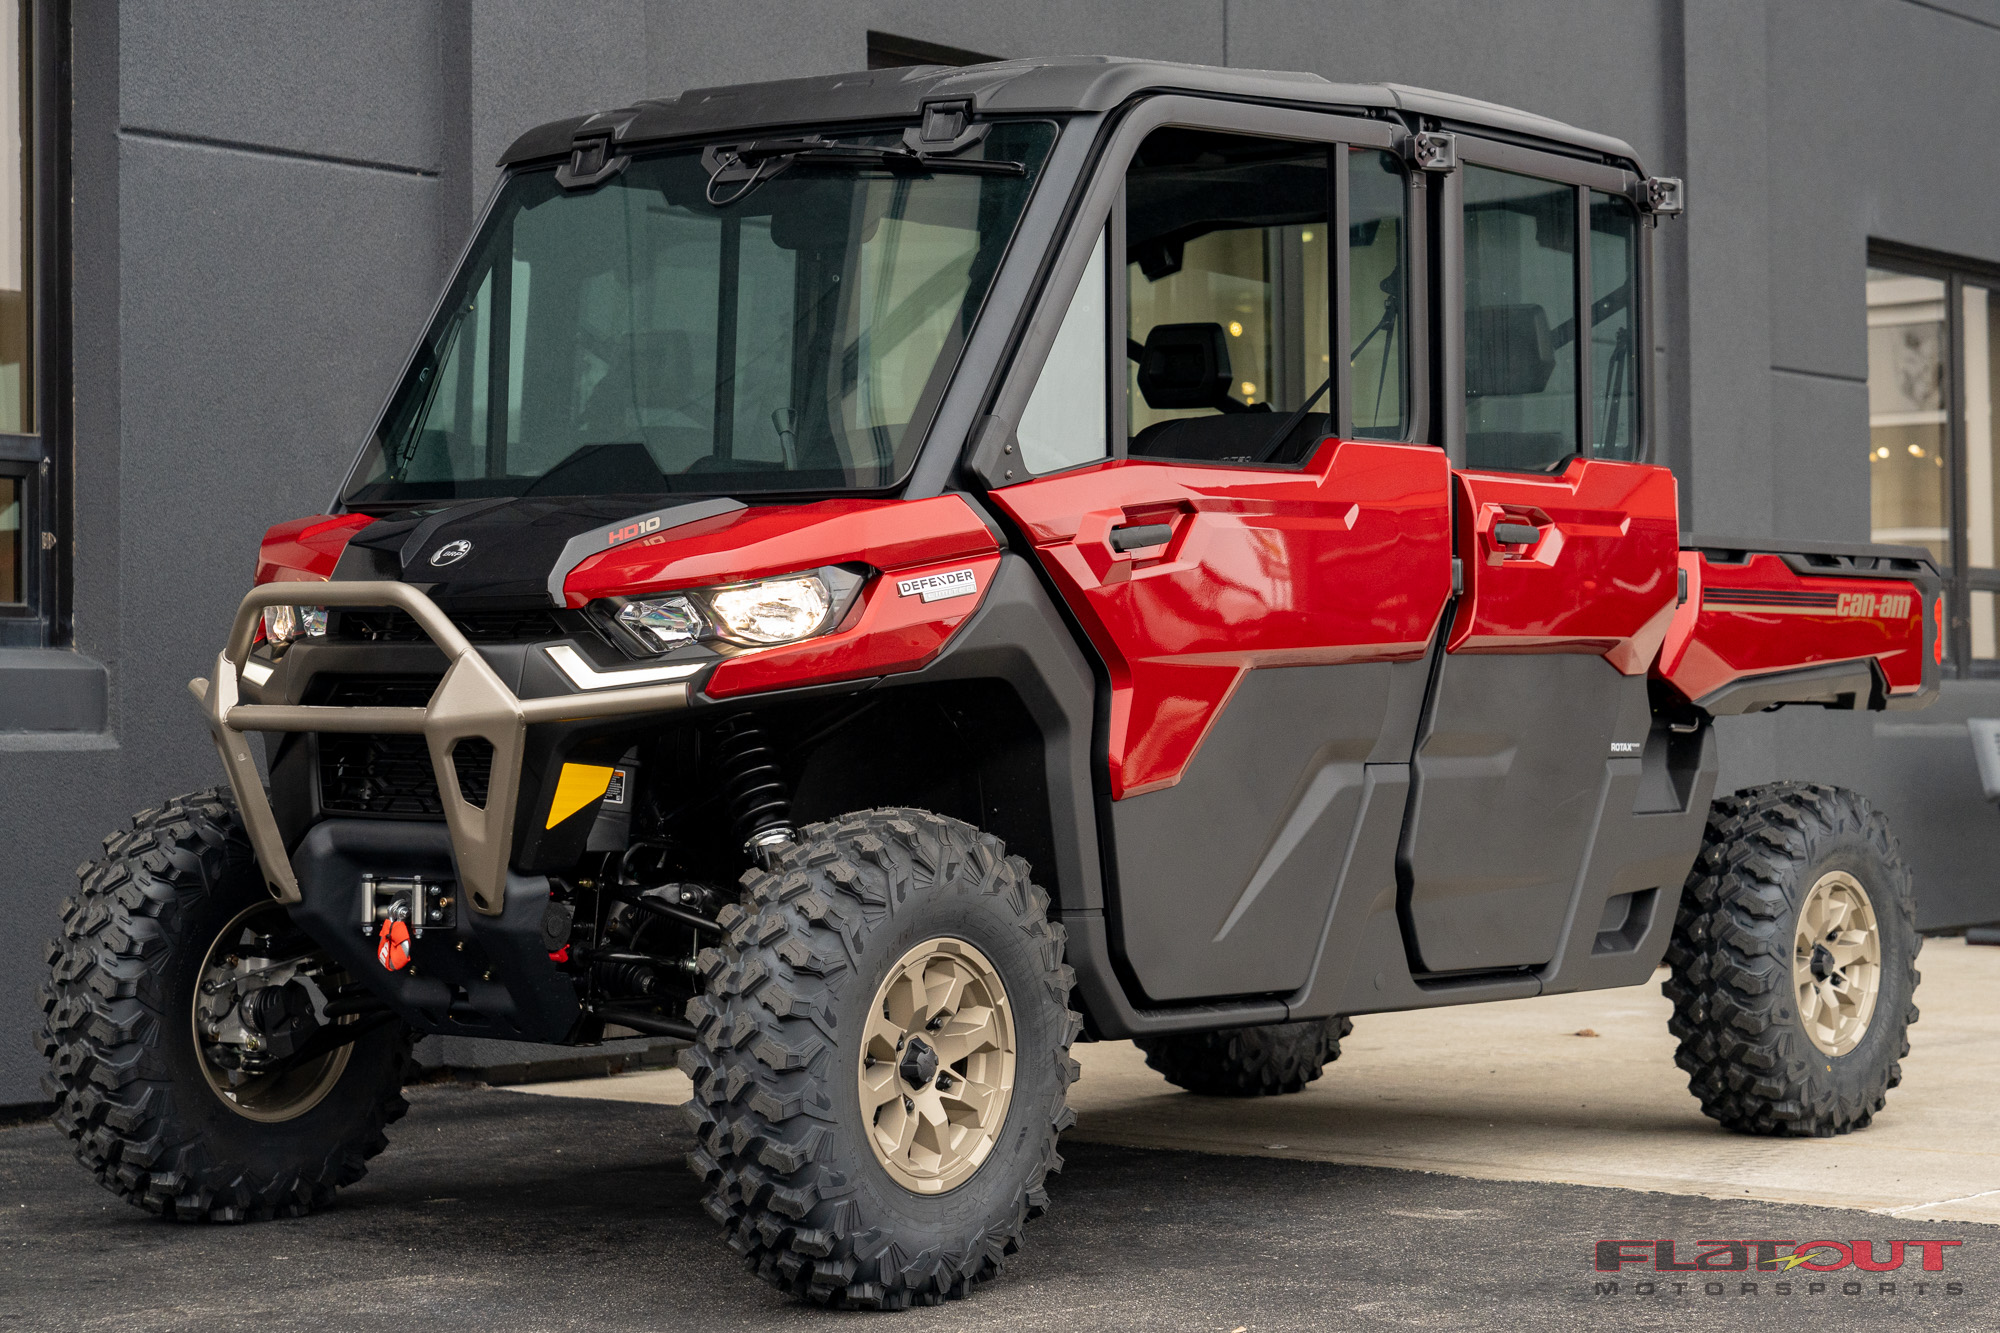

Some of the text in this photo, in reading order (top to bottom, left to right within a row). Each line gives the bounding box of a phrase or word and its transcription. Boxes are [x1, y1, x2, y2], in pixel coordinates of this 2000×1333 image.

[608, 516, 661, 545] HD10
[901, 570, 974, 593] DEFENDER
[1837, 593, 1911, 619] can-am
[1610, 742, 1632, 752] ROTAX
